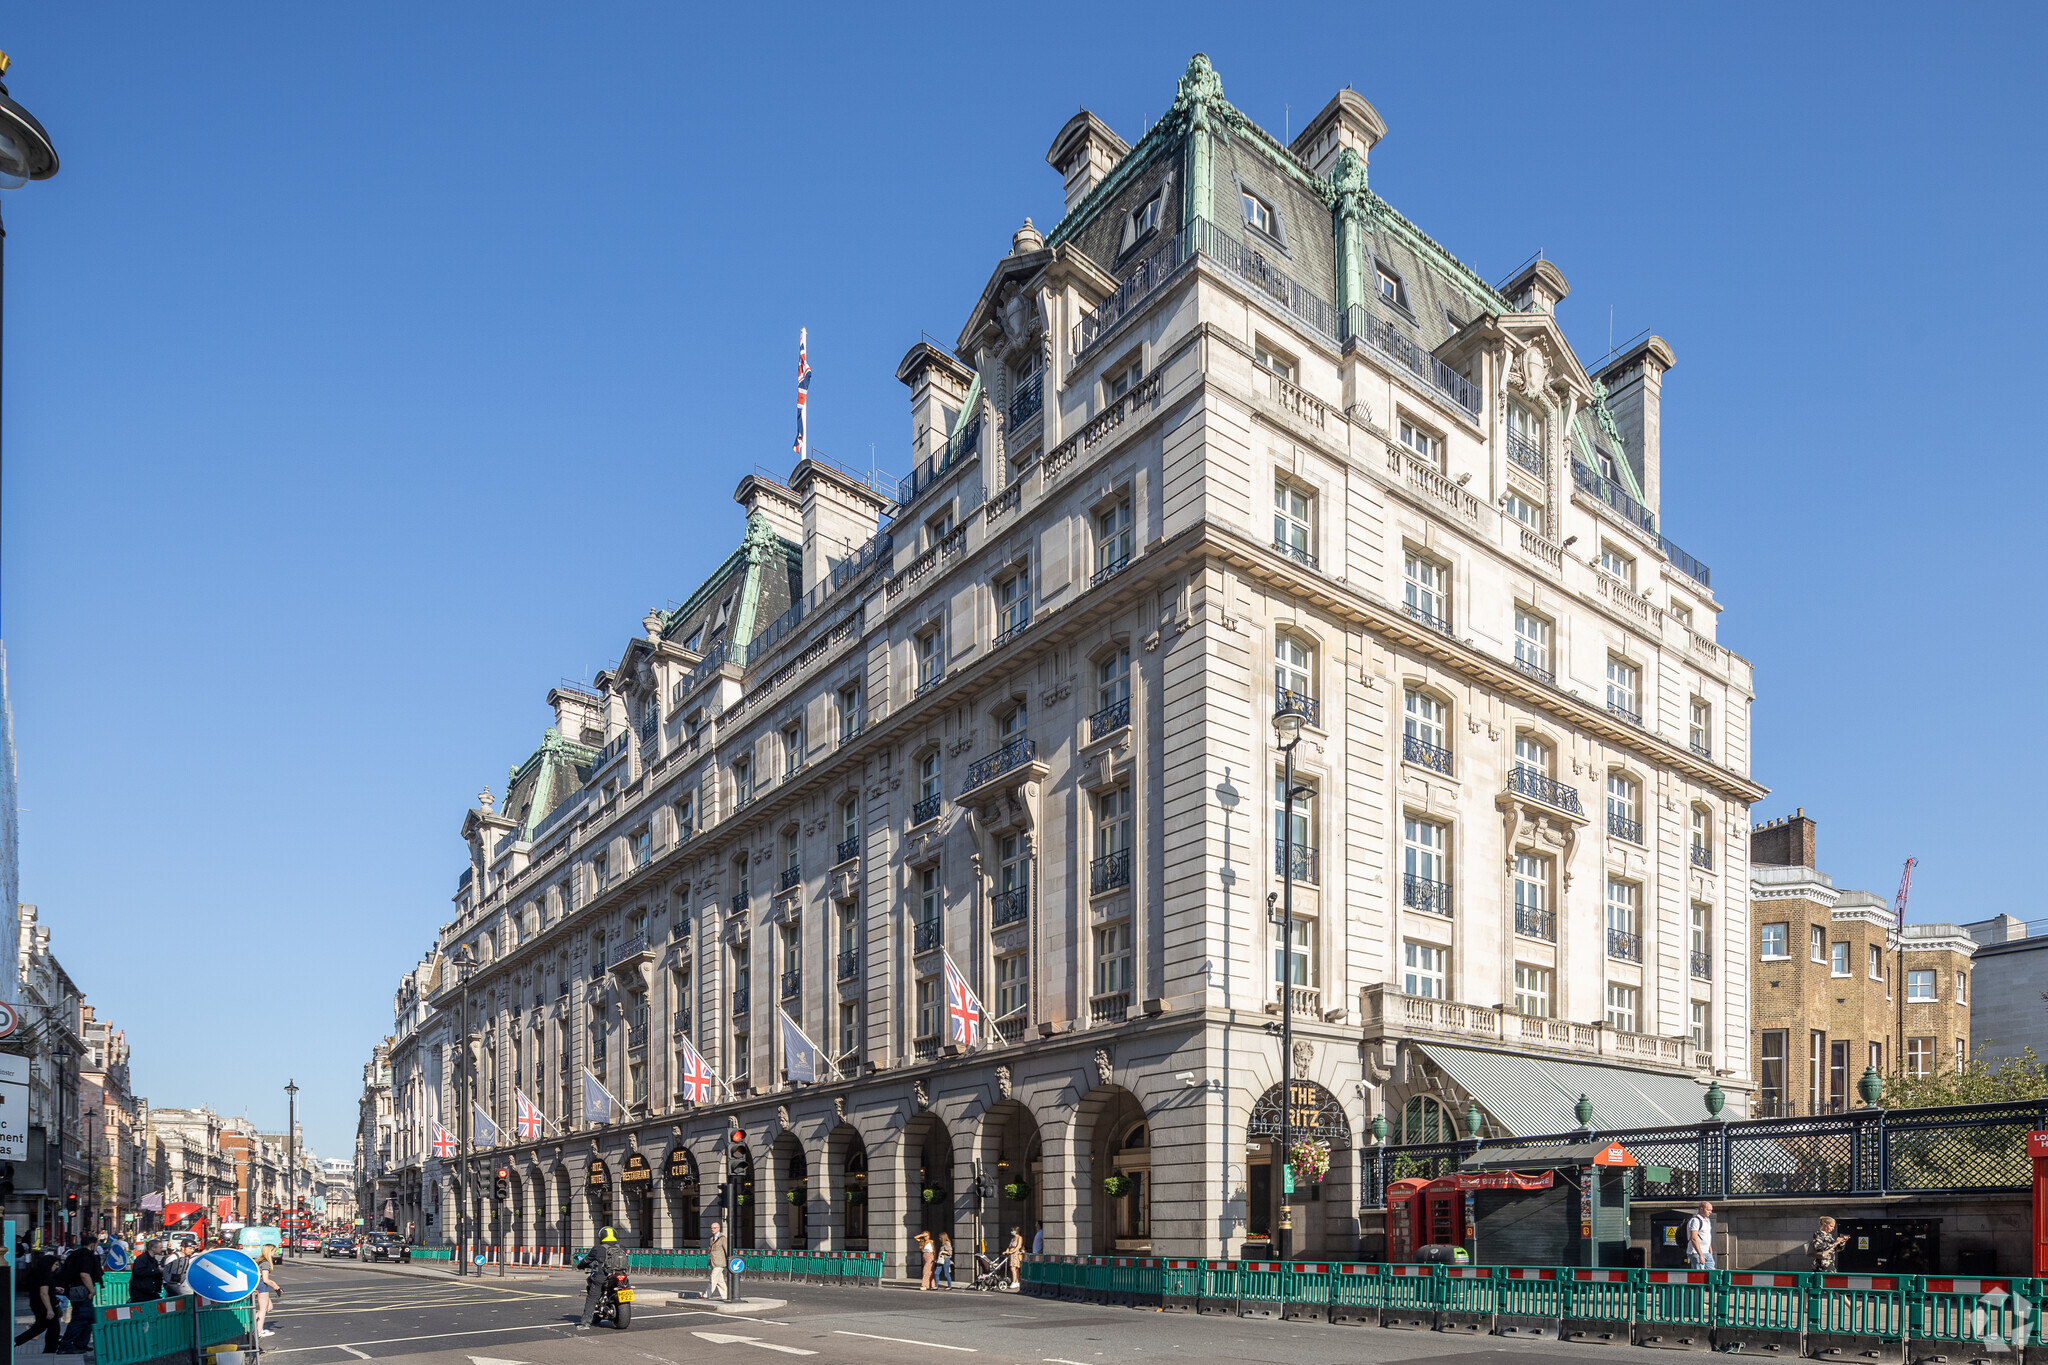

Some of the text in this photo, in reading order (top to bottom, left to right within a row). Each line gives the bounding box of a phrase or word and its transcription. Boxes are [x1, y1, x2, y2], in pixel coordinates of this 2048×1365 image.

[1290, 1087, 1316, 1105] THE
[1289, 1109, 1320, 1127] RITZ
[673, 1150, 686, 1162] RITZ
[592, 1162, 602, 1172] RITZ
[671, 1164, 686, 1176] CLUB
[590, 1174, 604, 1184] HOTEL
[622, 1169, 651, 1182] RESTAURANT
[1498, 1177, 1528, 1185] TICKETS
[1529, 1177, 1550, 1186] HERE
